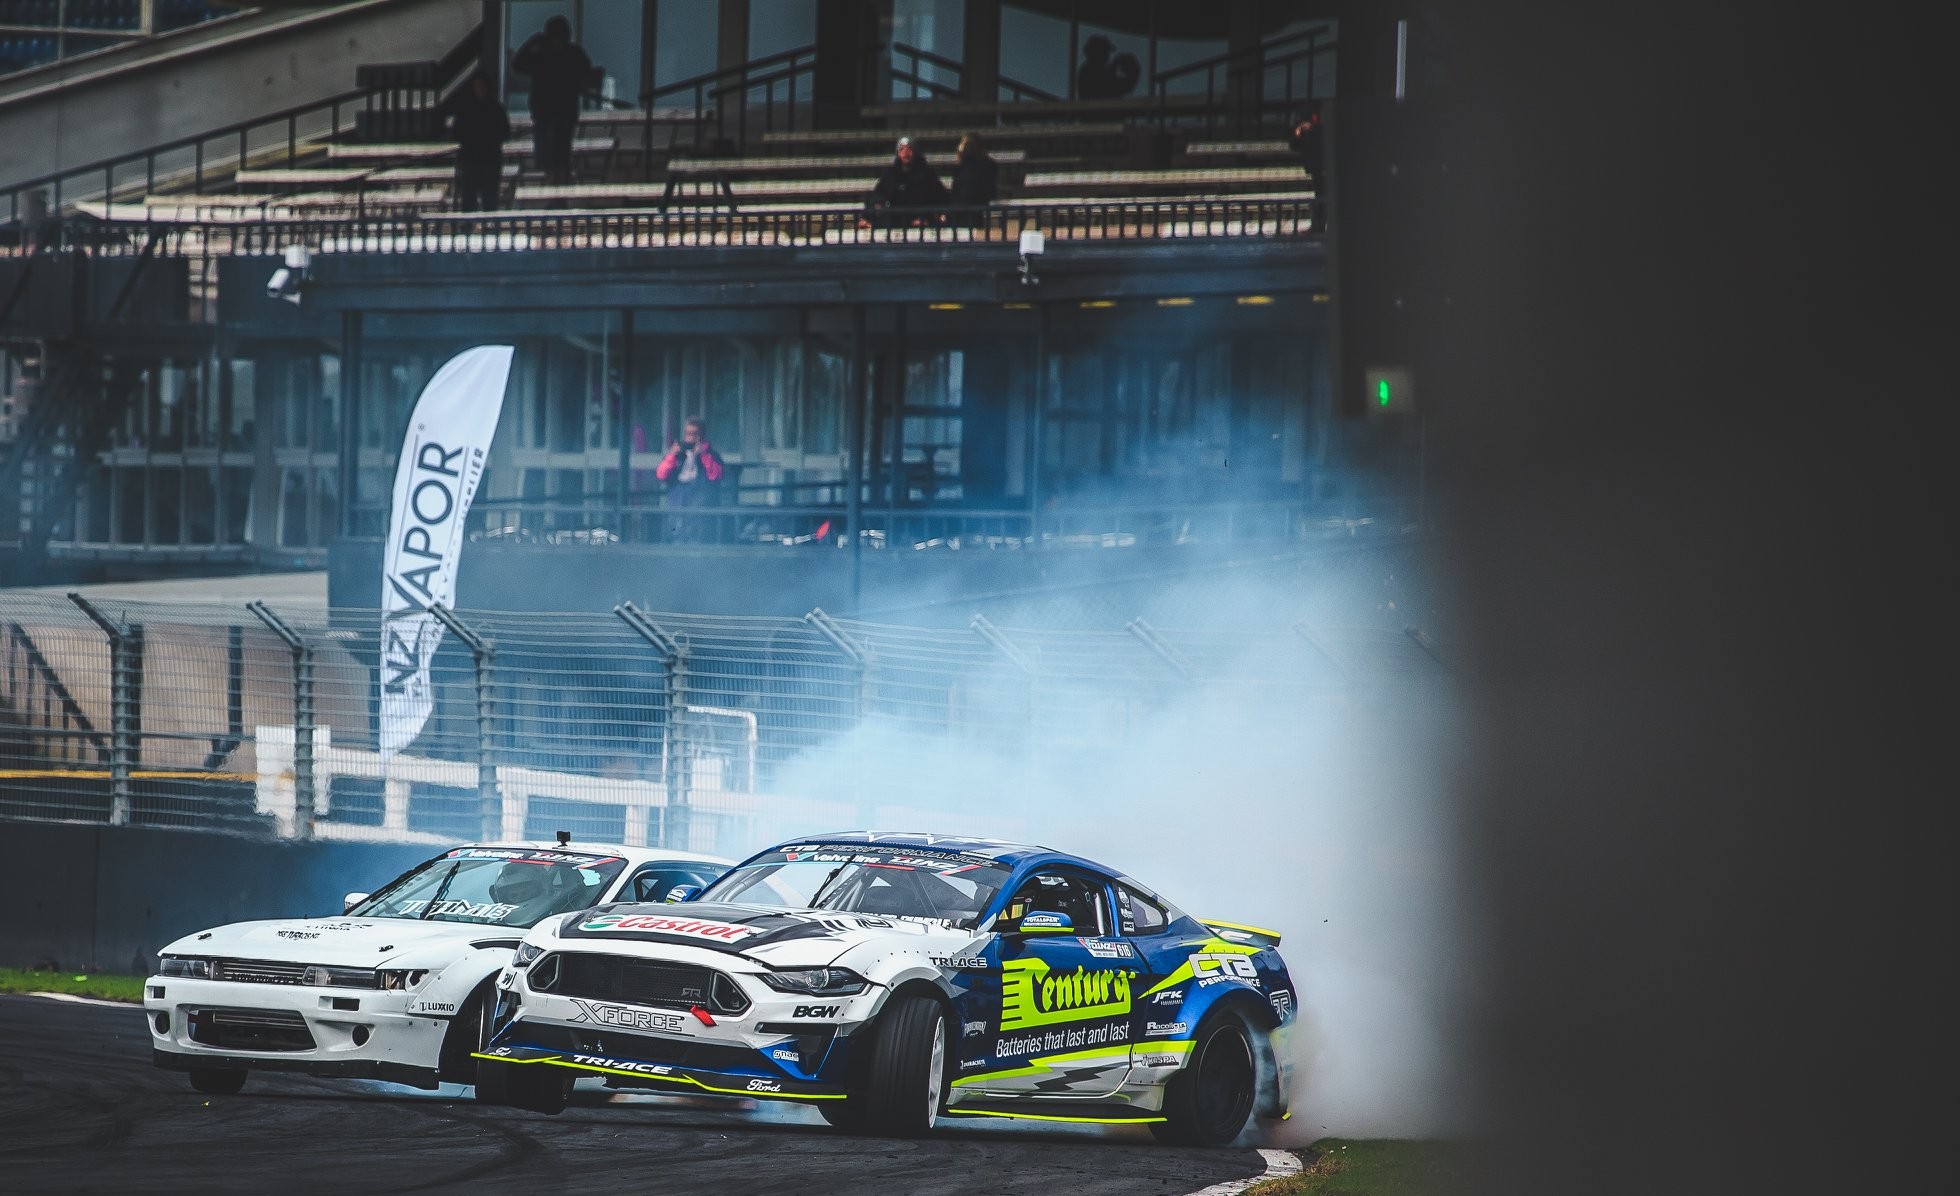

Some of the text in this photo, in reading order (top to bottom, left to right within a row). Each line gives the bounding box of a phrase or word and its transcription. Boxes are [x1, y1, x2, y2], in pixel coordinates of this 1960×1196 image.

[617, 915, 749, 939] Castrol
[1000, 957, 1135, 1031] Century
[1152, 990, 1183, 1004] JFK
[428, 1002, 455, 1011] LUXXIO
[566, 998, 686, 1032] XFORCE
[792, 1005, 841, 1018] BGW
[996, 1020, 1130, 1058] Batteries that last and last
[573, 1054, 673, 1075] TRI-ACE
[747, 1079, 781, 1092] Ford
